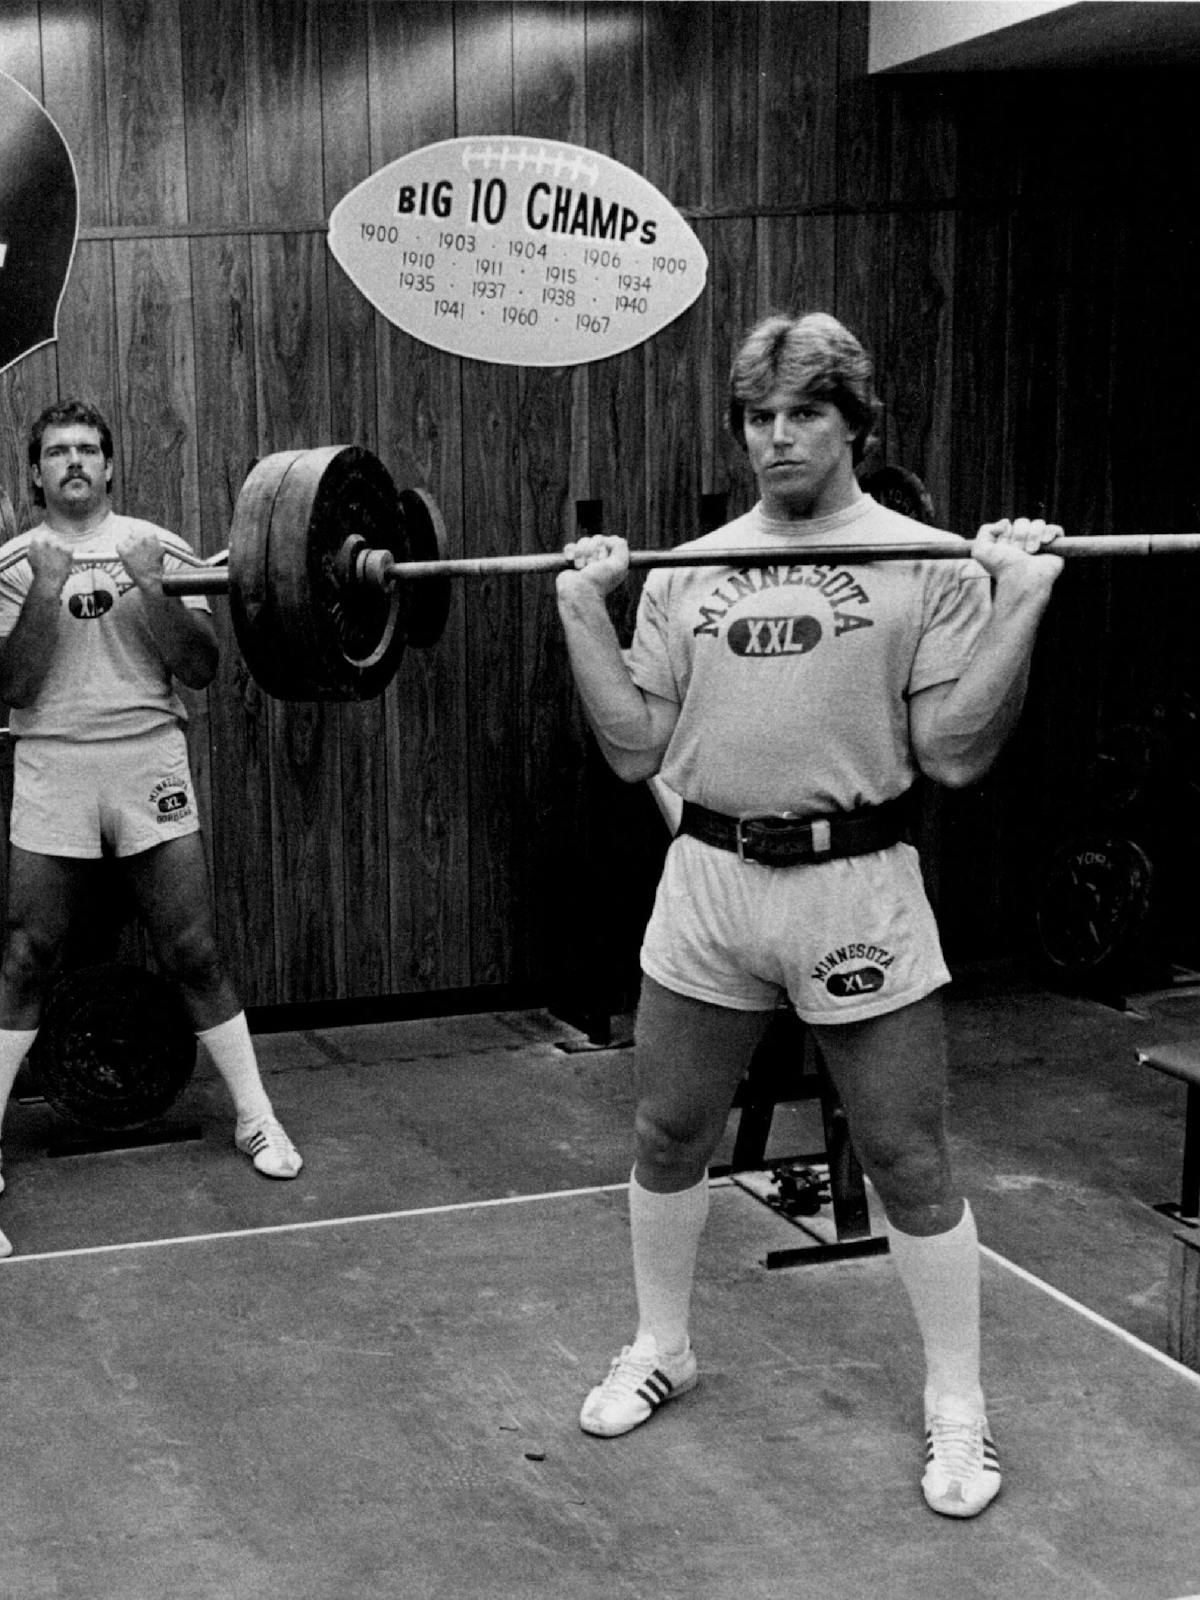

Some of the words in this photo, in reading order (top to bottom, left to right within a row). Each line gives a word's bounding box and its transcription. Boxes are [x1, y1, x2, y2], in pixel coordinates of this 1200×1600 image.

[397, 179, 453, 218] BIG
[471, 177, 507, 225] 10
[527, 182, 657, 244] CHAMPS
[361, 223, 398, 244] 1900
[439, 232, 476, 252] 1903
[509, 240, 548, 260] 1904
[584, 249, 621, 268] 1906
[652, 256, 687, 275] 1909
[403, 251, 435, 270] 1910
[476, 259, 503, 276] 1911
[546, 266, 577, 284] 1915
[618, 274, 652, 292] 1934
[399, 272, 435, 292] 1935
[472, 281, 506, 299] 1937
[542, 287, 575, 307] 1938
[615, 295, 648, 314] 1940
[434, 300, 465, 320] 1941
[503, 307, 538, 326] 1960
[576, 313, 610, 333] 1967
[693, 566, 874, 637] MINNESOTA
[745, 619, 804, 654] XXL
[811, 943, 895, 982] MINNESOTA
[842, 974, 874, 992] XL
